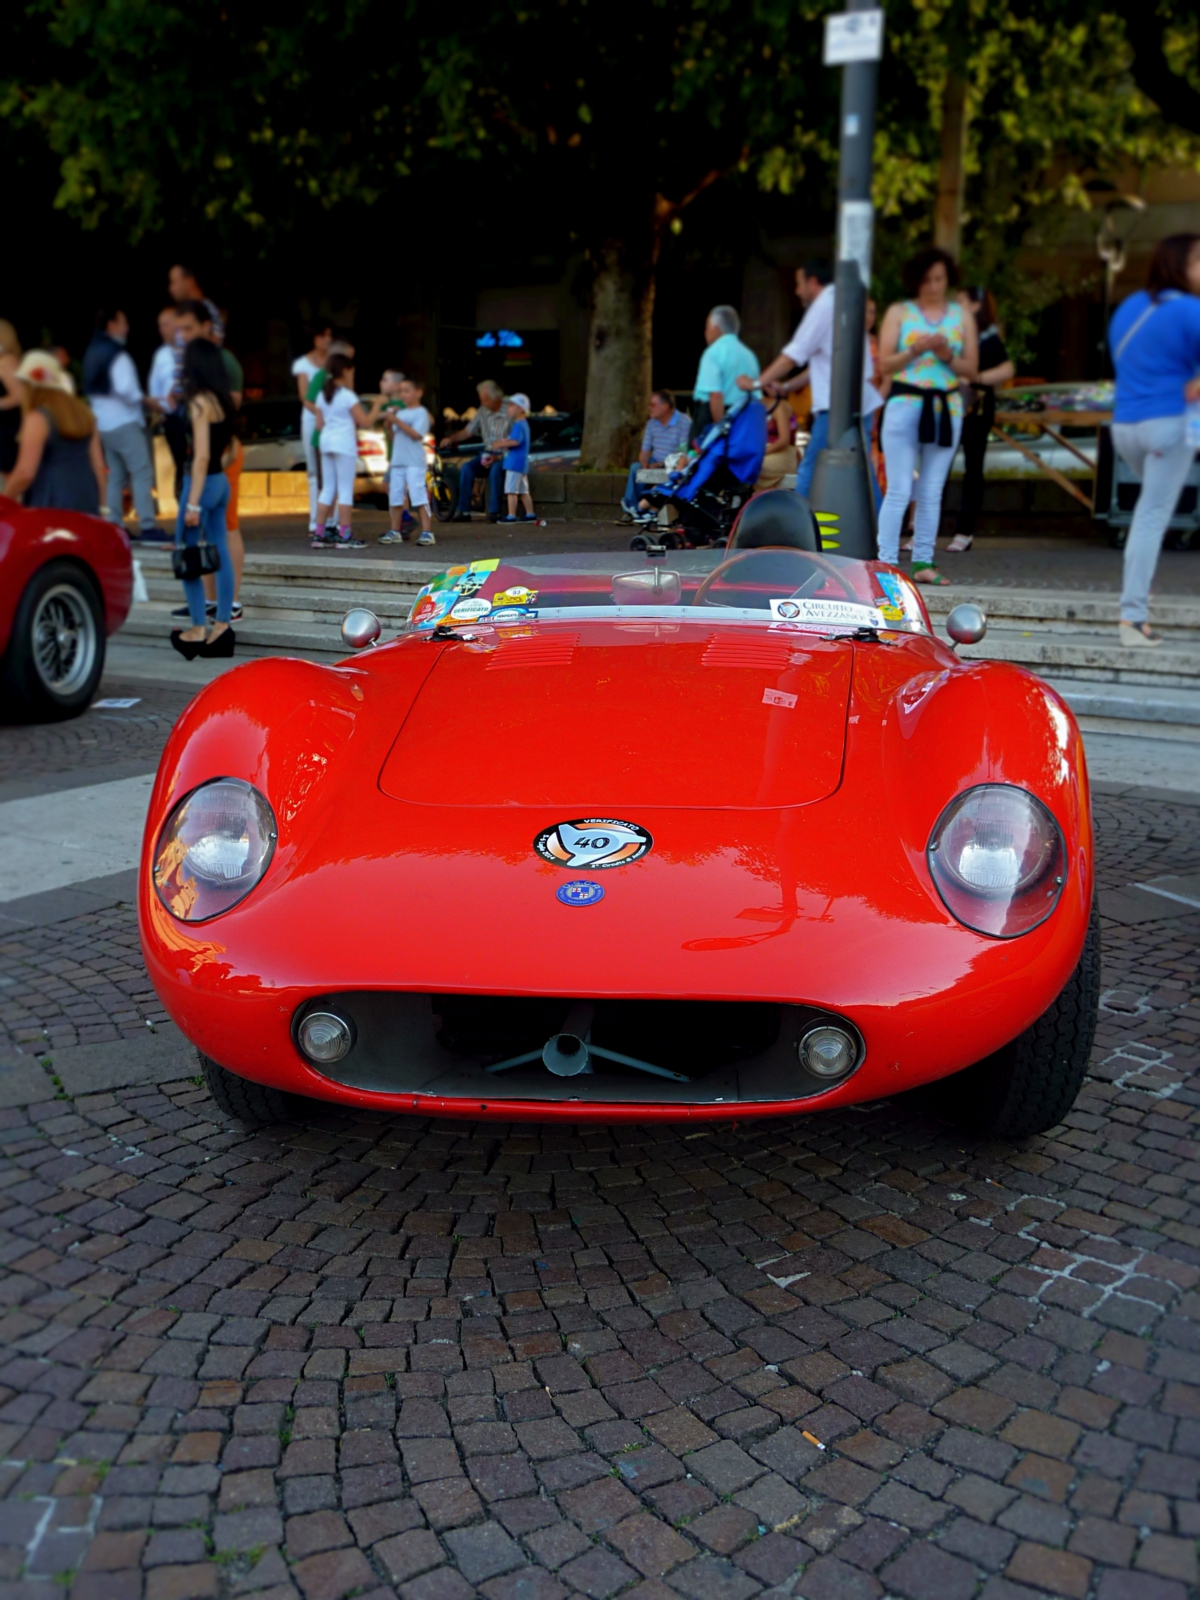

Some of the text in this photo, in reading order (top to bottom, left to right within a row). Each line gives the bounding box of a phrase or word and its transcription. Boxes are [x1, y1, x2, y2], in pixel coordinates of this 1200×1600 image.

[453, 606, 489, 614] VERIFICATO
[802, 602, 853, 613] CIRCUITO
[805, 609, 864, 621] AVEZZANO
[583, 818, 640, 831] VERIFICATO
[573, 836, 611, 850] 40
